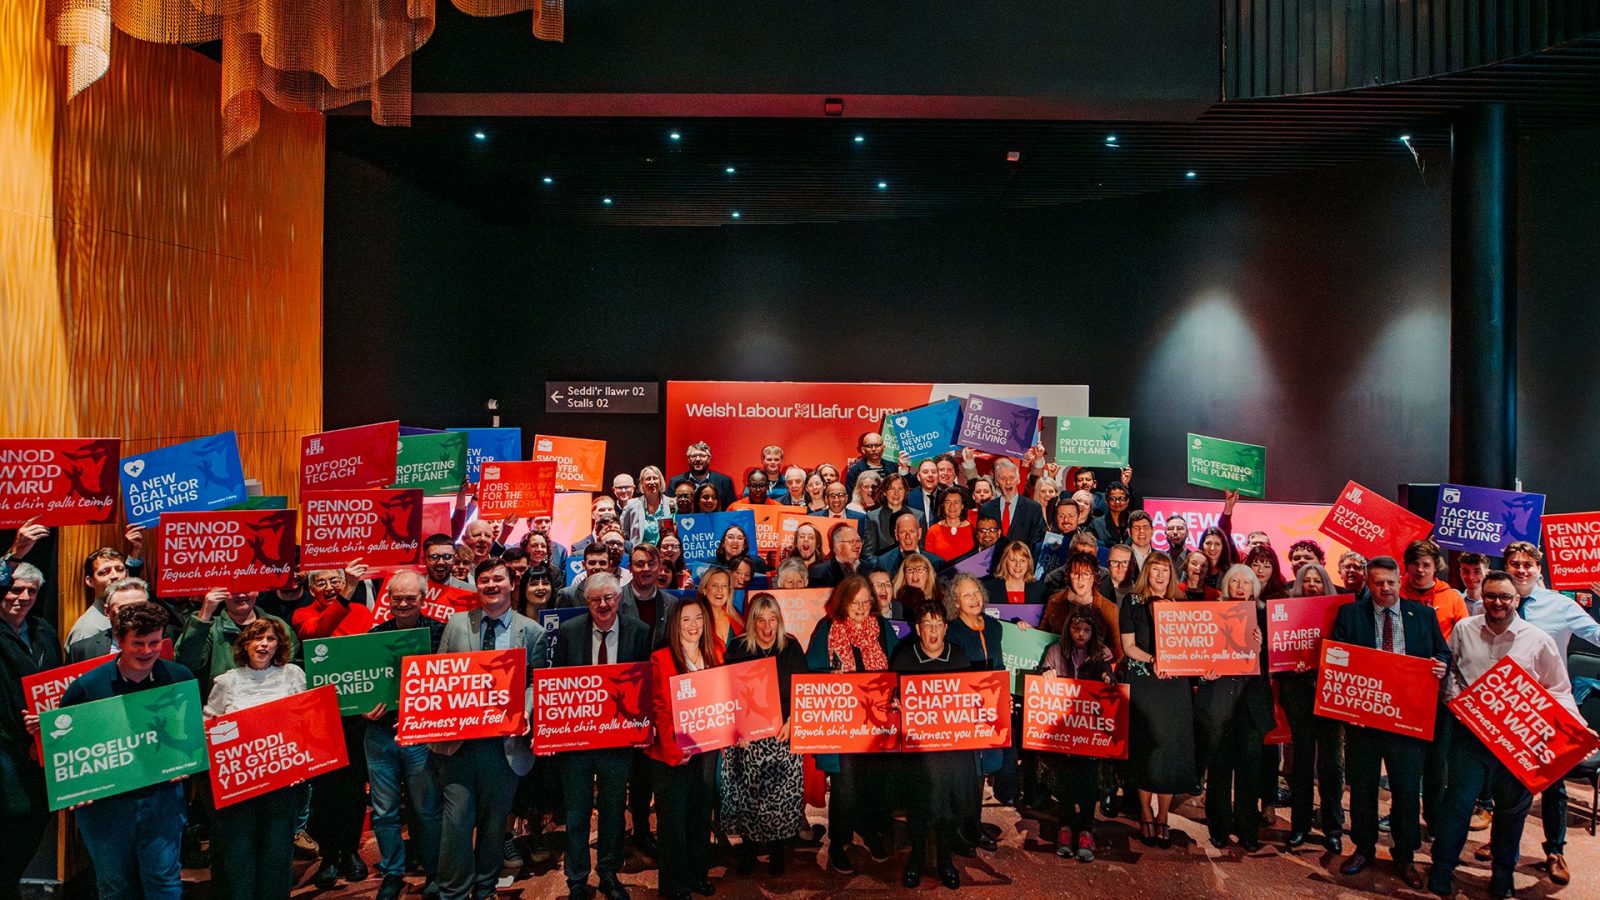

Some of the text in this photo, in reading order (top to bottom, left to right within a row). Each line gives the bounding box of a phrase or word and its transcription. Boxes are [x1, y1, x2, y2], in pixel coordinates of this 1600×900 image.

[568, 386, 645, 396] Seddi'r llawr 02
[568, 398, 609, 408] Stalls 02
[686, 402, 854, 419] Welsh Labour Llafur
[966, 420, 1010, 437] THE COST
[968, 413, 1002, 428] TACKLE
[900, 430, 915, 440] DÊL
[902, 431, 939, 446] NEWYDD
[964, 429, 1007, 445] OF LIVING
[1060, 438, 1117, 448] PROTECTING
[916, 441, 933, 450] GIG
[1078, 447, 1112, 455] PLANET
[305, 456, 363, 474] DYFODOL
[397, 460, 455, 474] ROTECTING
[476, 457, 494, 465] FOR
[536, 455, 573, 464] SWYDDI
[1192, 457, 1252, 475] PROTECTING
[305, 467, 356, 484] TECACH
[412, 470, 449, 482] PLANET
[556, 472, 584, 481] FODOL
[558, 465, 578, 473] YFER
[1192, 465, 1248, 482] THE PLANET
[129, 472, 176, 495] A NEW
[483, 483, 509, 492] JOBS
[131, 478, 199, 506] DEAL FOR
[483, 491, 522, 500] FOR THE
[14, 496, 44, 510] chi'n
[47, 496, 76, 511] gallu
[78, 496, 113, 507] teimlo
[132, 500, 164, 516] OUR
[167, 490, 198, 507] NHS
[307, 499, 373, 513] PENNOD
[482, 500, 518, 510] FUTURE
[307, 513, 378, 526] NEWYDD
[1152, 511, 1166, 527] A
[1336, 505, 1385, 538] DYFODOL
[1442, 506, 1489, 521] TACKLE
[166, 521, 239, 535] PENNOD
[1332, 513, 1376, 543] TECACH
[1440, 516, 1503, 533] THE COST
[1547, 521, 1600, 535] PENNO
[306, 527, 372, 540] I GYMRU
[692, 532, 714, 541] NEW
[1439, 526, 1500, 543] OF LIVING
[1549, 534, 1600, 548] NEWY
[165, 535, 246, 550] NEWYDD
[304, 539, 418, 556] Tegwch chi'n gallu teimlo
[683, 540, 721, 550] DEAL FO
[165, 550, 238, 565] I GYMRU
[683, 550, 704, 559] OUR
[1551, 550, 1556, 561] I
[162, 566, 201, 582] Tegwch
[205, 565, 230, 578] chi'n
[233, 564, 256, 578] gallu
[260, 563, 291, 574] teimlo
[1552, 562, 1589, 576] Tegwch
[1158, 610, 1212, 622] PENNOD
[1159, 623, 1217, 635] NEWYDD
[1272, 628, 1320, 642] A FAIRER
[1160, 636, 1214, 648] I GYMRU
[1273, 640, 1314, 653] FUTURE
[1159, 650, 1188, 664] Tegwch
[1211, 649, 1230, 662] gallu
[1232, 650, 1256, 660] teimlo
[406, 657, 471, 677] A NEW
[313, 666, 394, 687] DIOGELU'R
[405, 673, 493, 695] CHAPTER
[538, 675, 602, 692] PENNOD
[1324, 668, 1383, 690] SWYDDI
[796, 682, 852, 695] PENNOD
[905, 678, 960, 694] A NEW
[1028, 680, 1081, 697] A NEW
[1322, 681, 1392, 704] AR GYFER
[1497, 664, 1553, 712] A NEW
[404, 689, 510, 713] FOR WALES
[538, 689, 608, 706] NEWYDD
[795, 696, 858, 709] NEWYDD
[905, 693, 981, 710] CHAPTER
[1027, 695, 1100, 715] CHAPTER
[1322, 692, 1332, 703] Y
[1334, 695, 1403, 719] DYFODOL
[538, 704, 602, 721] I GYMRU
[679, 699, 742, 723] DYFODOL
[1486, 673, 1555, 741] CHAPTER
[402, 709, 507, 731] Fairness you Feel
[680, 713, 736, 734] TECACH
[795, 710, 852, 723] I GYMRU
[906, 708, 997, 726] FOR WALES
[1028, 710, 1115, 732] FOR WALES
[1472, 683, 1506, 715] FOR
[1503, 712, 1555, 764] WALES
[537, 717, 650, 738] Tegwch chi'n gallu teimlo
[794, 725, 824, 740] Tegwch
[850, 724, 869, 738] gallu
[871, 724, 897, 735] teimlo
[906, 724, 995, 742] Fairness you Feel
[1458, 694, 1500, 736] Fairness
[1495, 735, 1516, 753] you
[1513, 750, 1540, 772] Feel
[1026, 726, 1070, 741] Fairness
[1072, 735, 1088, 746] you
[1092, 733, 1112, 746] Feel
[53, 730, 158, 768] DIOGELU'R
[215, 732, 284, 764] SWYDDI
[55, 751, 134, 782] BLANED
[218, 759, 241, 778] AR
[245, 741, 298, 768] GYFER
[219, 775, 230, 790] Y
[235, 750, 314, 786] DYFODOL
